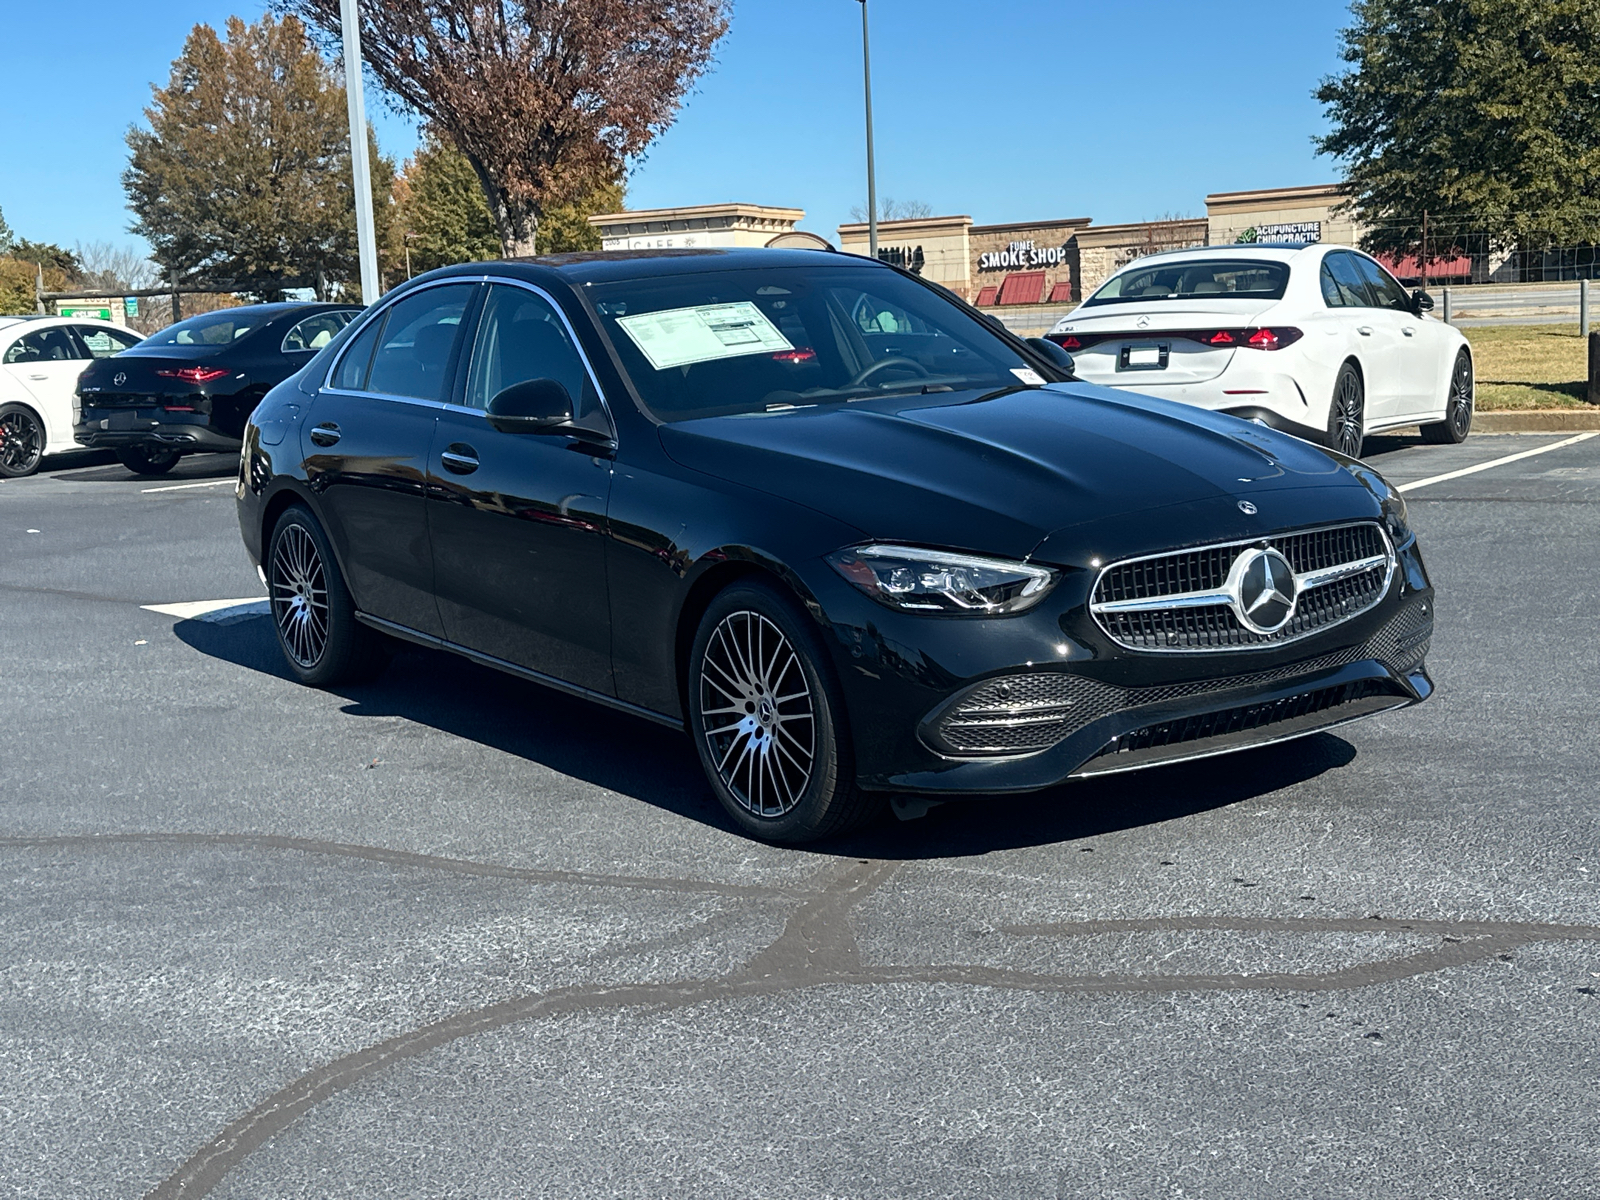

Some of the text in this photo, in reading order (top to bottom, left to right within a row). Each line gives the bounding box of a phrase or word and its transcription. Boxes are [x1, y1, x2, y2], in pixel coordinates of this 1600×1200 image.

[1256, 222, 1320, 235] ACUPUNCTURE
[1256, 231, 1320, 244] CHIROPRACTIC
[981, 247, 1066, 268] SMOKE SHOP
